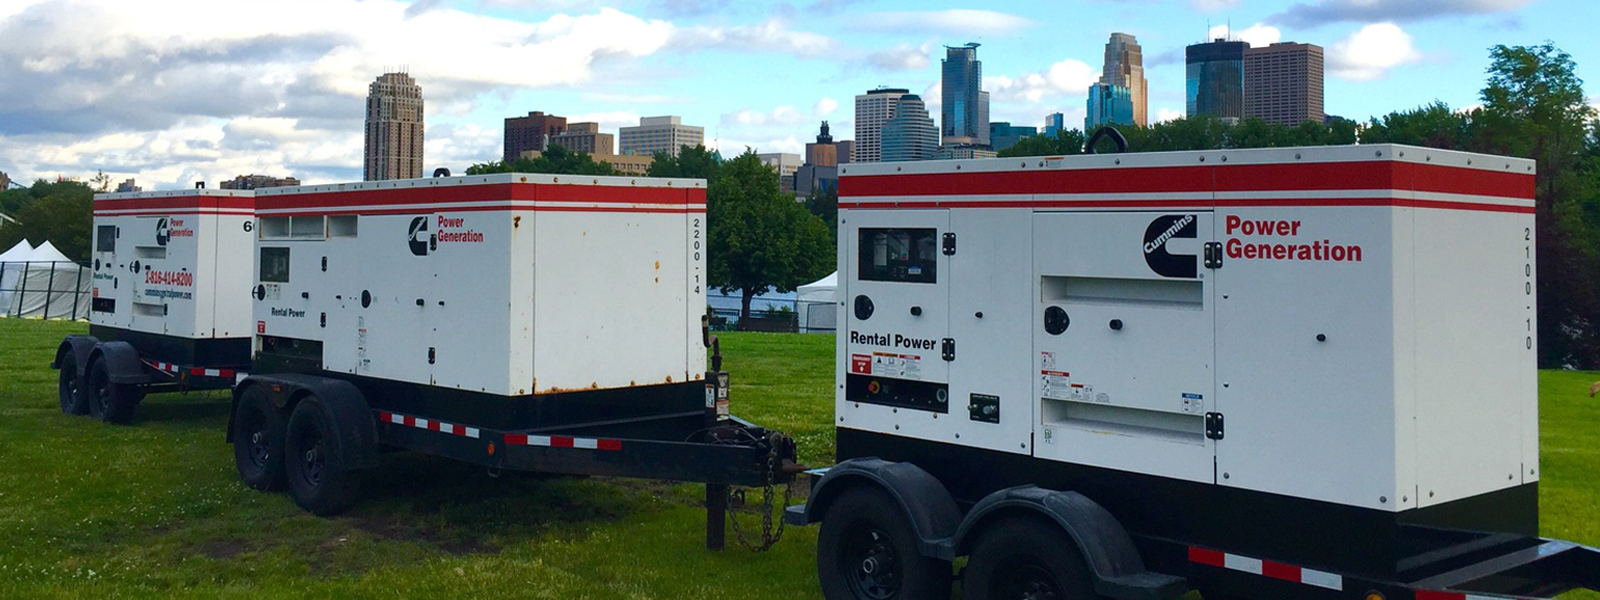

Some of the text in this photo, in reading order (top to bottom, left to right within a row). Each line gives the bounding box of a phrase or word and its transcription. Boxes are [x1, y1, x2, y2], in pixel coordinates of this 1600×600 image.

[170, 218, 184, 226] Power
[243, 221, 255, 232] 6
[437, 215, 464, 228] Power
[1225, 214, 1301, 236] Power
[437, 229, 484, 242] Generation
[1143, 213, 1193, 254] Cummins
[1225, 238, 1362, 261] Generation
[145, 270, 192, 287] 1-816-414-8200
[271, 307, 305, 317] Rental Power
[850, 330, 936, 350] Rental Power
